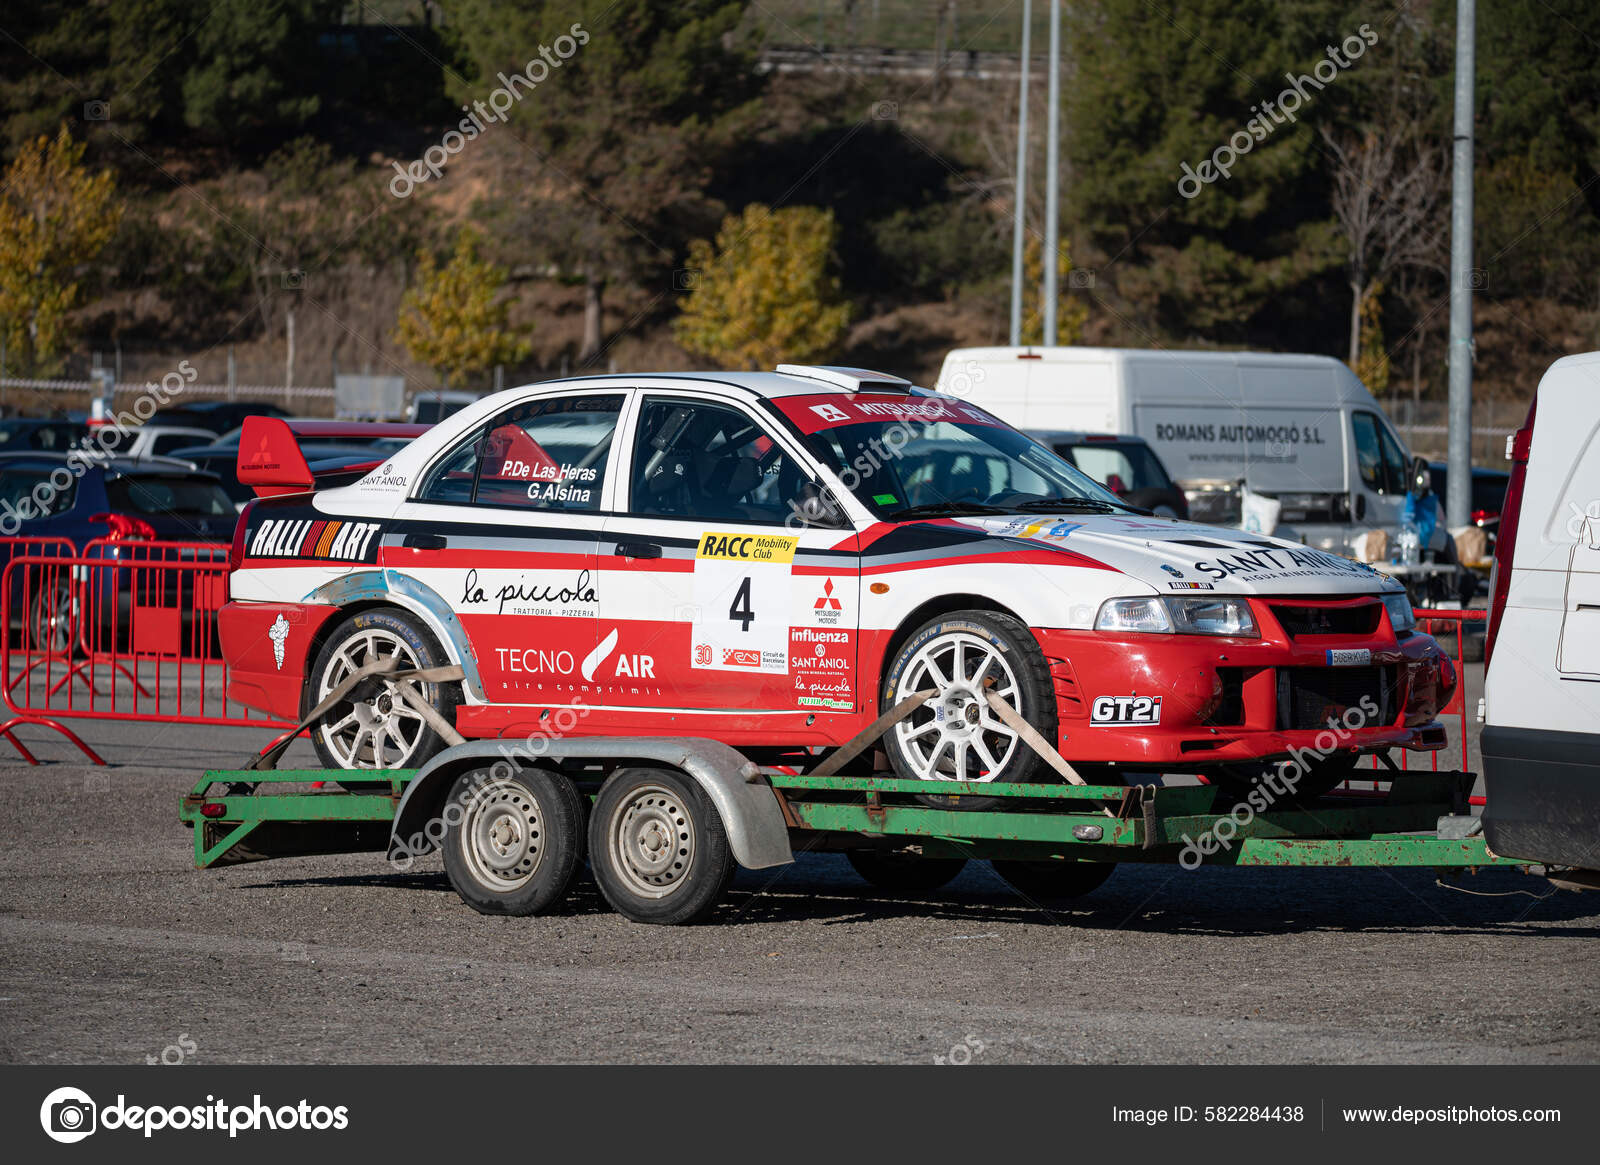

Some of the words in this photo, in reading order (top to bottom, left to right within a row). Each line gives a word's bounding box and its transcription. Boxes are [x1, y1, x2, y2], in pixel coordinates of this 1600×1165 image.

[1156, 424, 1215, 441] ROMANS
[1303, 426, 1325, 444] S.L.
[501, 461, 530, 477] P.De
[532, 462, 556, 478] Las
[559, 463, 597, 481] Heras
[381, 477, 407, 487] ANIOL
[527, 483, 591, 502] G.Alsina
[250, 520, 313, 556] RALLI
[329, 522, 381, 560] ART
[702, 535, 753, 558] RACC
[755, 538, 793, 551] Mobility
[753, 549, 772, 560] Club
[1194, 549, 1286, 580] SANT
[1242, 572, 1279, 582] AIGUA
[460, 568, 489, 605] la
[495, 568, 600, 615] piccola
[513, 607, 552, 616] TRATTORIA
[729, 576, 755, 632] 4
[791, 629, 849, 643] influenza
[495, 648, 574, 675] TECNO
[615, 653, 656, 679] AIR
[694, 644, 713, 665] 30
[791, 656, 817, 668] SANT
[818, 658, 850, 670] ANIOL
[503, 682, 543, 691] aire
[556, 684, 664, 696] comprimit
[794, 675, 807, 690] la
[808, 677, 852, 696] piccola
[1091, 696, 1162, 722] GT2i
